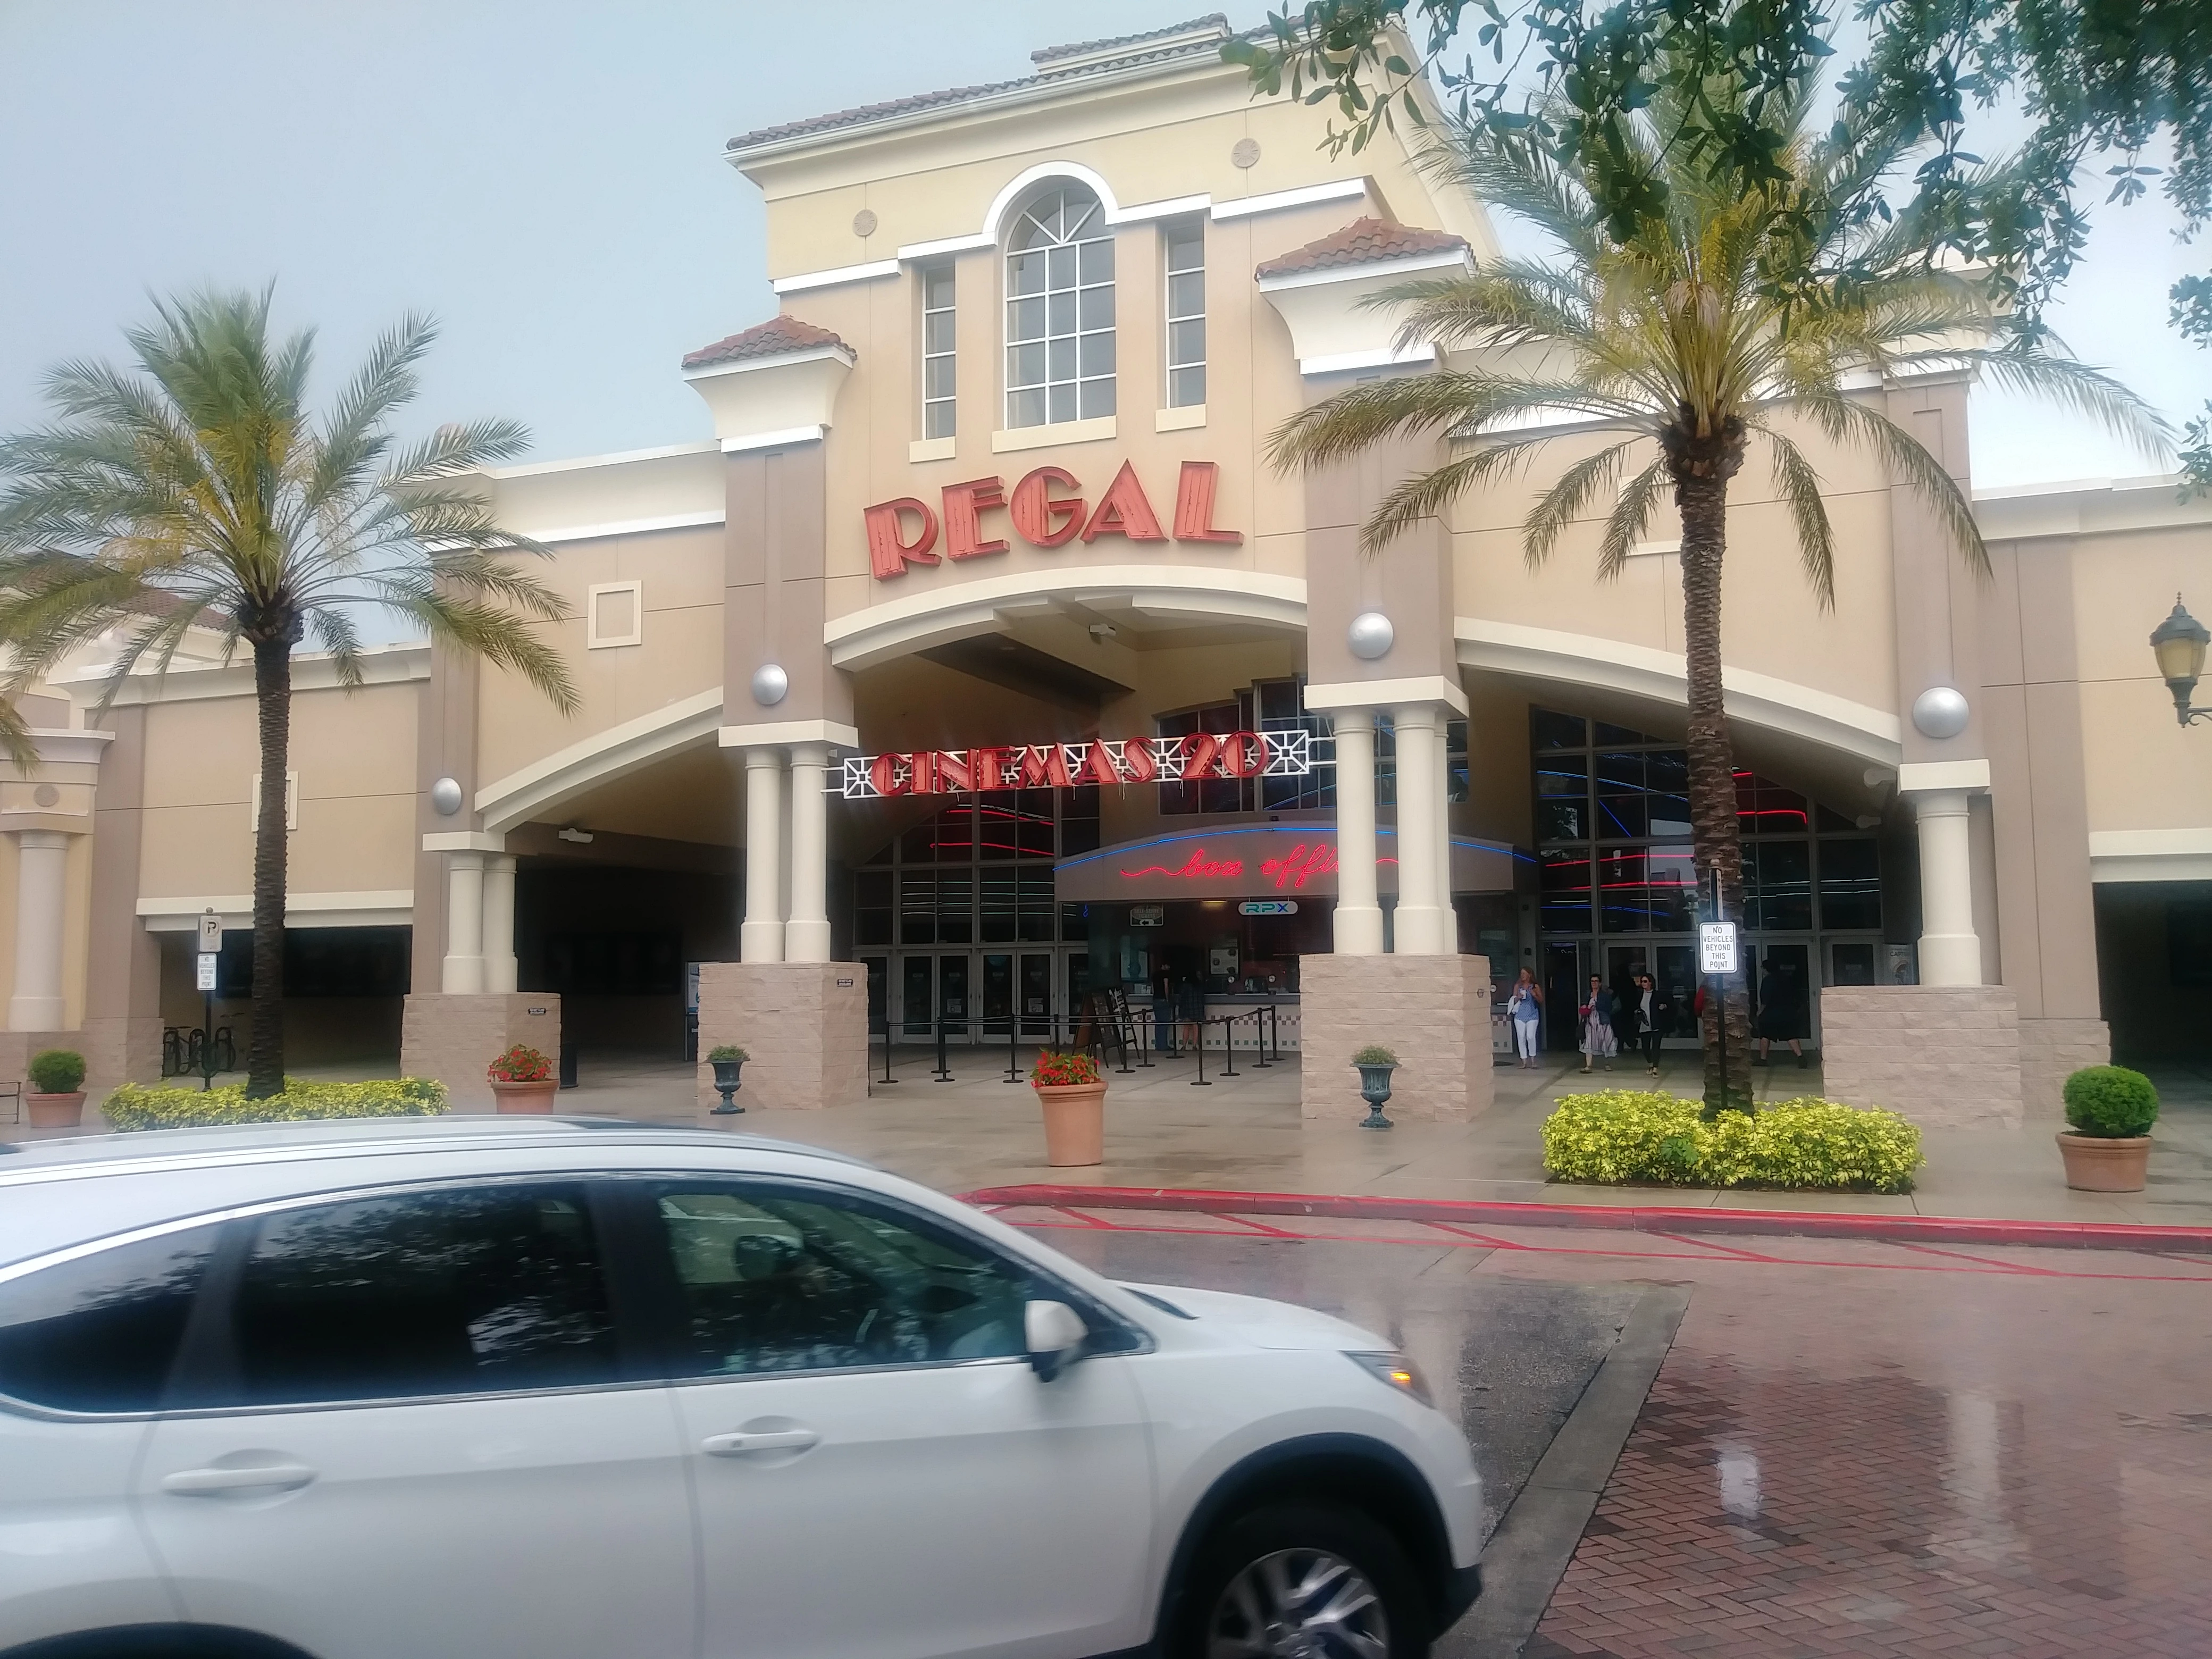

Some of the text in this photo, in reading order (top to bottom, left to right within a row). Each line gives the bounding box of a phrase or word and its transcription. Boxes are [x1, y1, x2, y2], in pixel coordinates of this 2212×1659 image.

[864, 458, 1245, 582] REGAL
[870, 730, 1270, 797] CINEMAS 20
[1180, 844, 1339, 887] box offi
[1245, 903, 1289, 913] RPX
[1710, 961, 1728, 969] POINT
